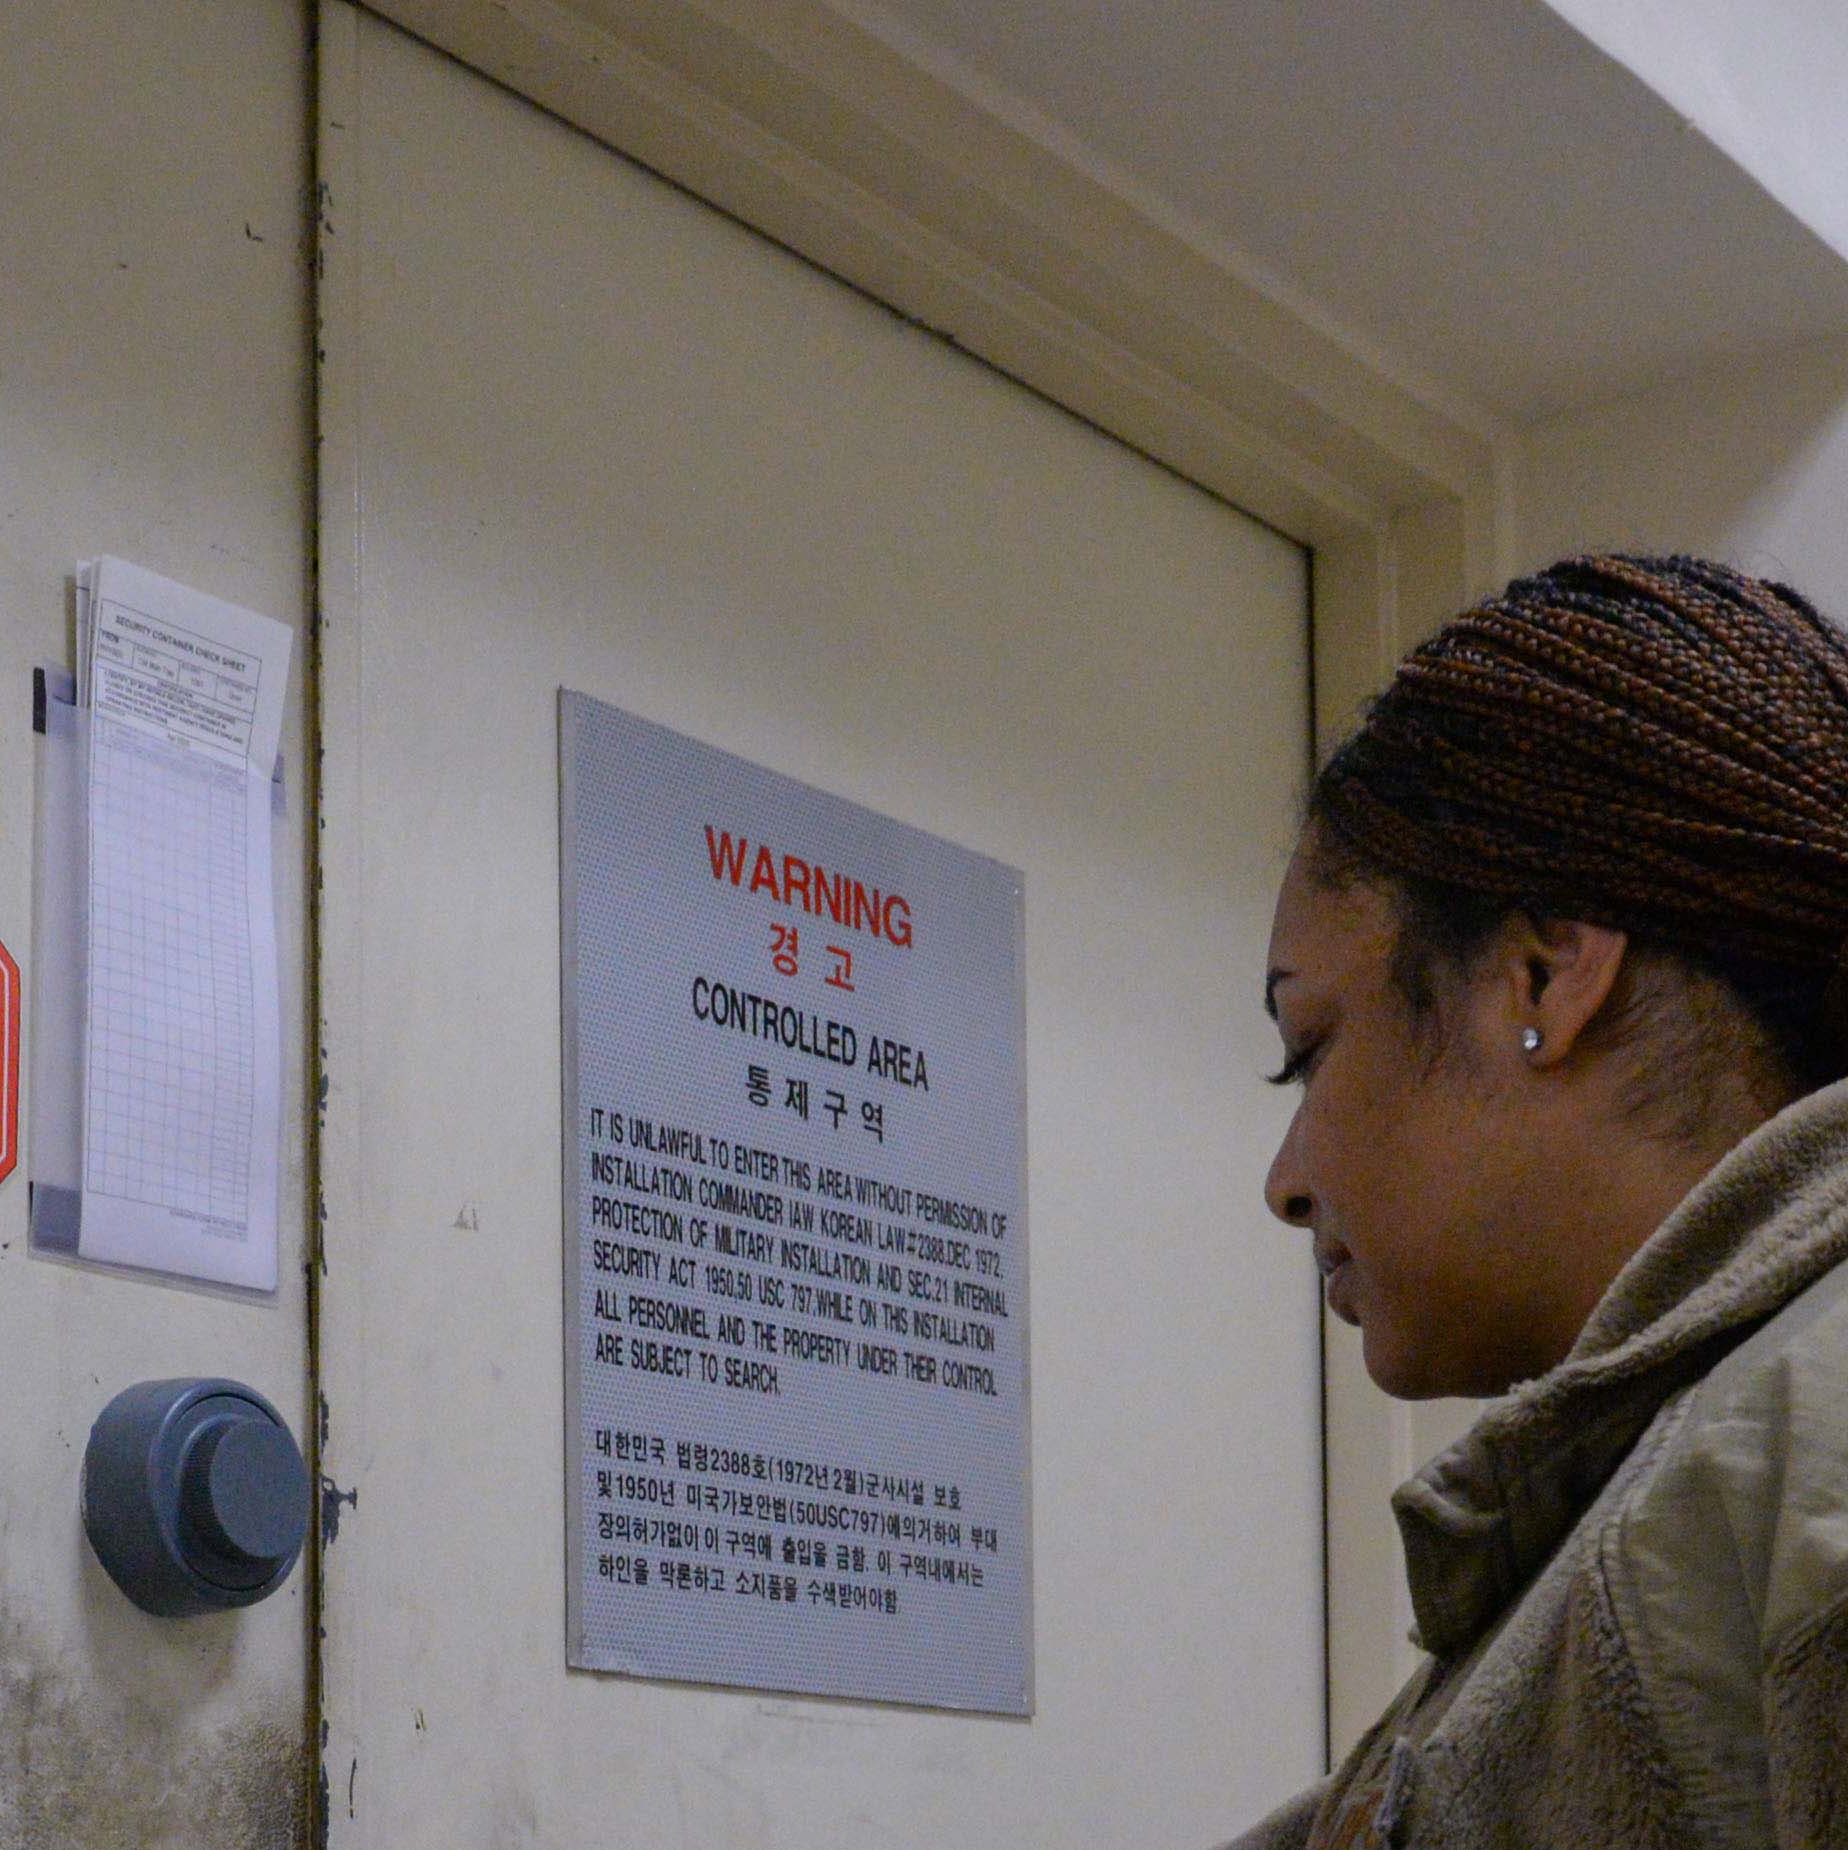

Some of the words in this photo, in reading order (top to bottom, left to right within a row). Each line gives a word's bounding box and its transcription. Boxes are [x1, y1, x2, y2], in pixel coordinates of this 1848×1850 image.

[705, 823, 913, 949] WARNING
[692, 976, 858, 1066] CONTROLLED
[867, 1035, 929, 1092] AREA
[590, 1106, 604, 1139] IT
[610, 1111, 623, 1144] IS
[628, 1115, 706, 1166] UNLAWFUL
[709, 1137, 729, 1172] TO
[734, 1143, 778, 1184] ENTER
[781, 1156, 811, 1192] THIS
[817, 1165, 852, 1203] AREA
[855, 1175, 913, 1218] WITHOUT
[916, 1191, 987, 1238] PERMISSION
[991, 1211, 1007, 1242] OF
[591, 1148, 692, 1205] INSTALLATION
[698, 1175, 783, 1227] COMMANDER
[820, 1206, 872, 1248] KOREAN
[592, 1193, 683, 1246] PROTECTION
[689, 1216, 707, 1250] OF
[714, 1222, 774, 1265] MILITARY
[780, 1238, 871, 1288] INSTALLATION
[876, 1261, 902, 1295] AND
[953, 1279, 1008, 1319] INTERNAL
[592, 1237, 661, 1284] SECURITY
[668, 1254, 696, 1291] ACT
[757, 1274, 784, 1309] USC
[858, 1297, 877, 1328] ON
[882, 1302, 908, 1335] THIS
[912, 1308, 995, 1354] INSTALLATION
[594, 1287, 622, 1323] ALL
[628, 1293, 710, 1341] PERSONNEL
[716, 1312, 745, 1347] AND
[751, 1319, 776, 1354] THE
[783, 1326, 850, 1369] PROPERTY
[856, 1341, 897, 1378] UNDER
[902, 1351, 936, 1385] THEIR
[942, 1359, 998, 1397] CONTROL
[595, 1331, 623, 1366] ARE
[631, 1337, 692, 1380] SUBJECT
[699, 1352, 718, 1384] TO
[595, 1427, 666, 1466] 대한민국
[933, 1483, 961, 1511] 보호
[598, 1551, 650, 1587] 하인을
[659, 1560, 725, 1595] 막론하고
[735, 1568, 798, 1603] 소지품을
[782, 1535, 827, 1569] 출입을
[877, 1550, 891, 1576] 이
[970, 1525, 998, 1554] 부대
